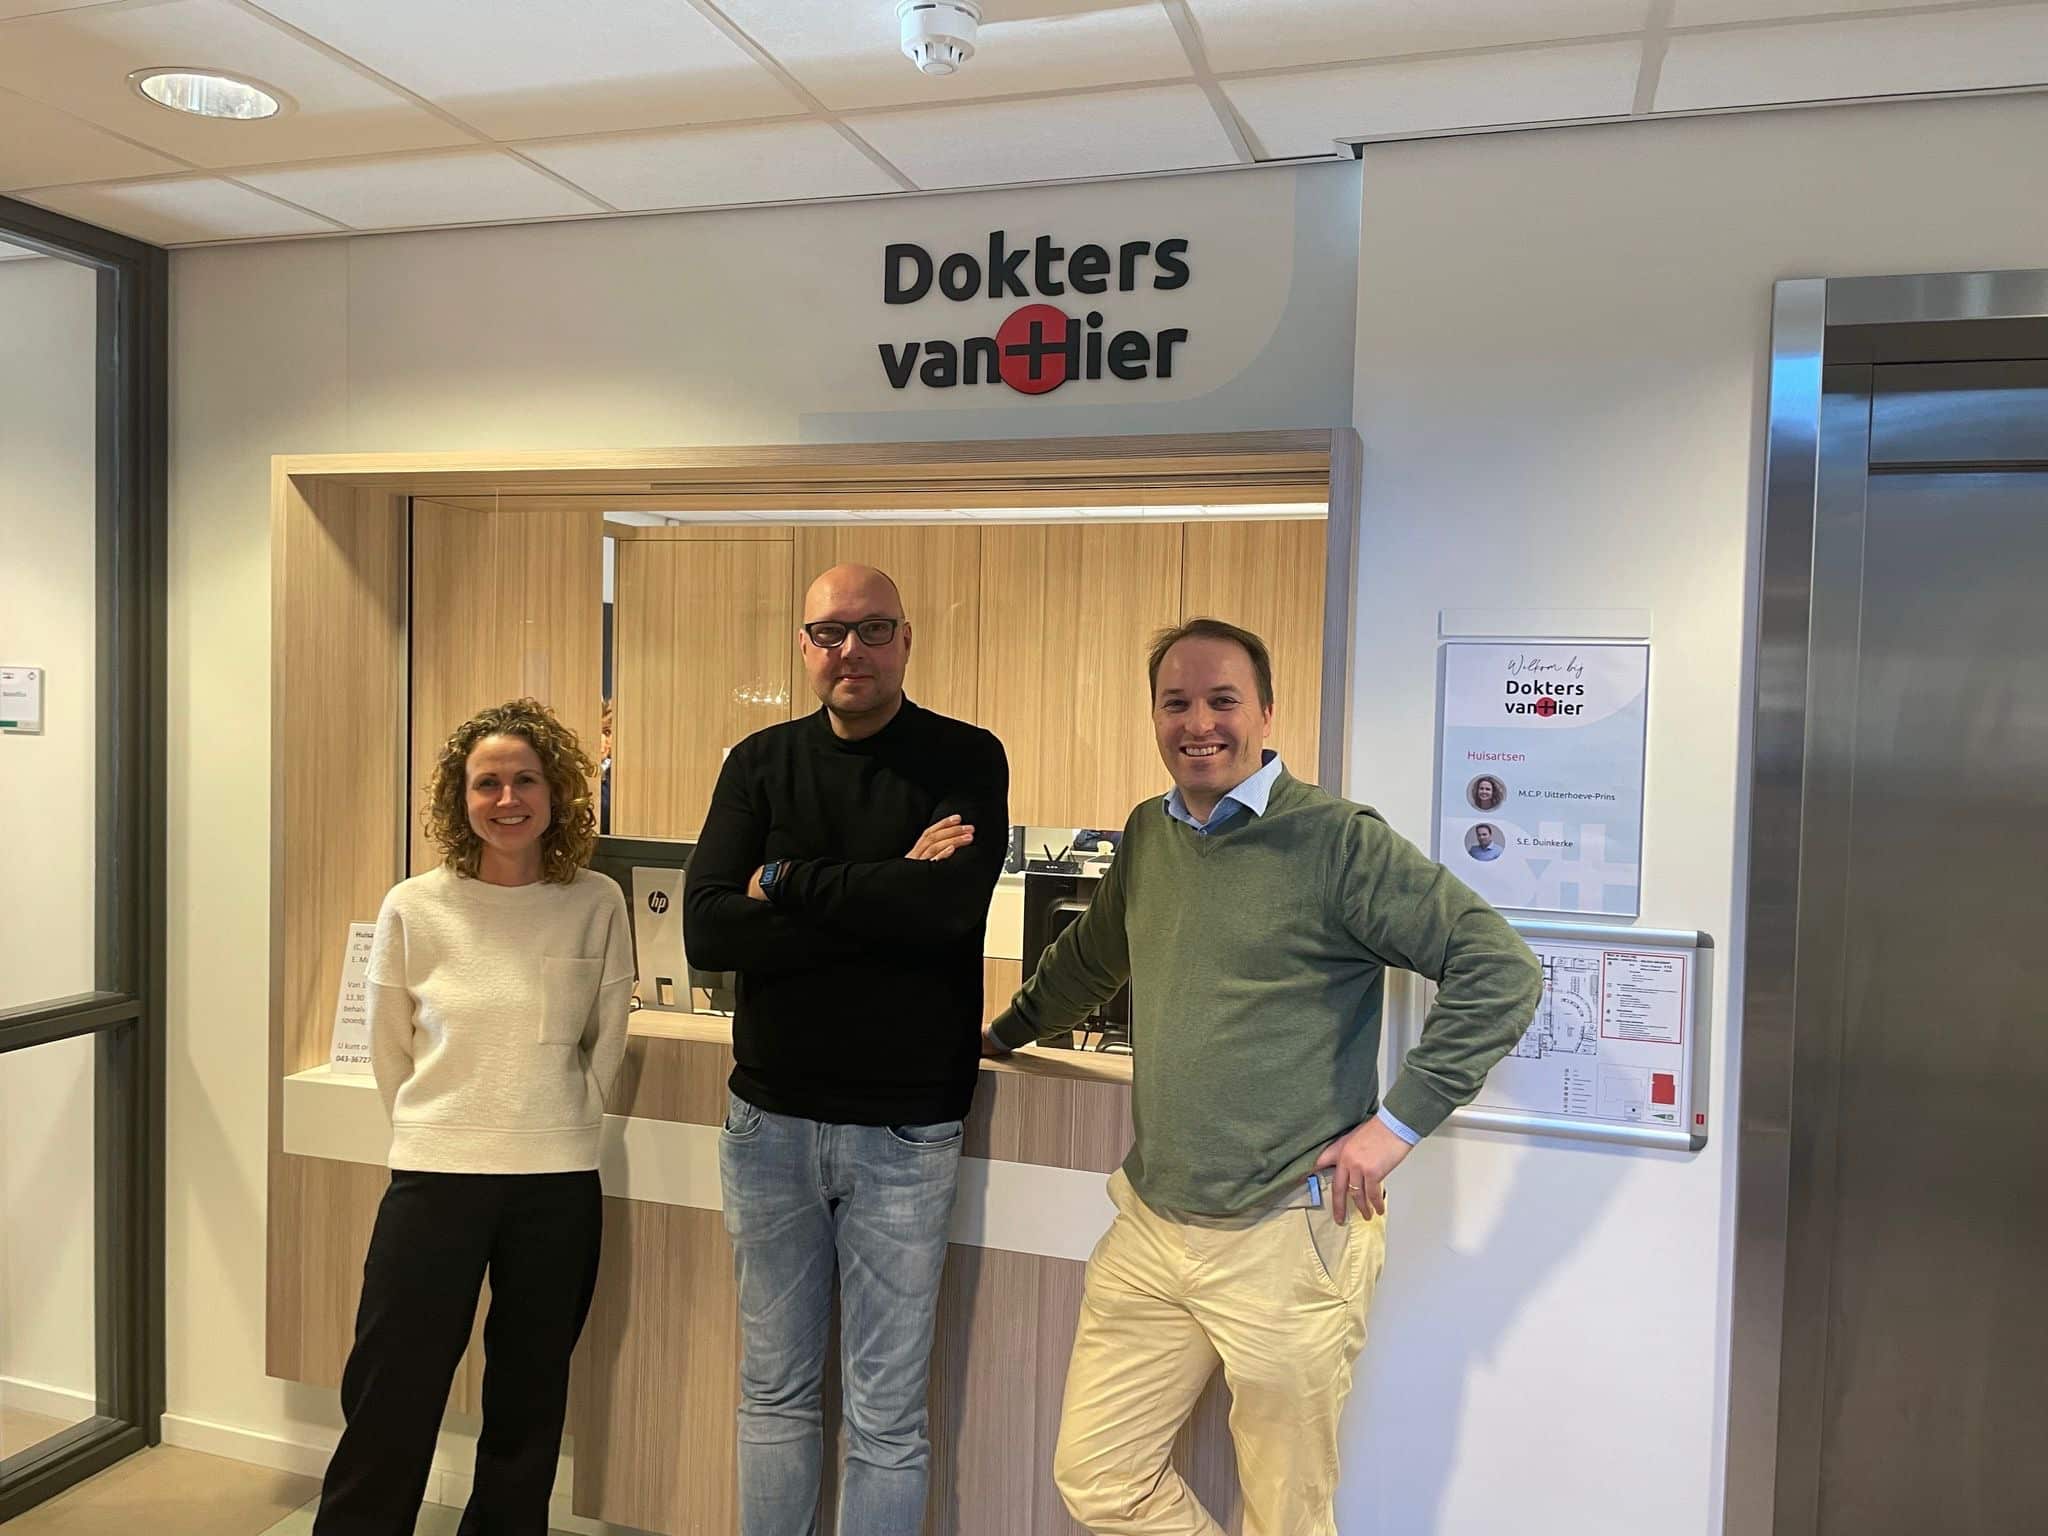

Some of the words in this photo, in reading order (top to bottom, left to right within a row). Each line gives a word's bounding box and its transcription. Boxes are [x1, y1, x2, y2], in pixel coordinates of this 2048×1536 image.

[884, 230, 1190, 304] Dokters
[1506, 680, 1584, 696] Dokters
[1467, 751, 1526, 762] Huisartsen
[1533, 839, 1574, 848] Duinkerke
[649, 890, 669, 914] hp
